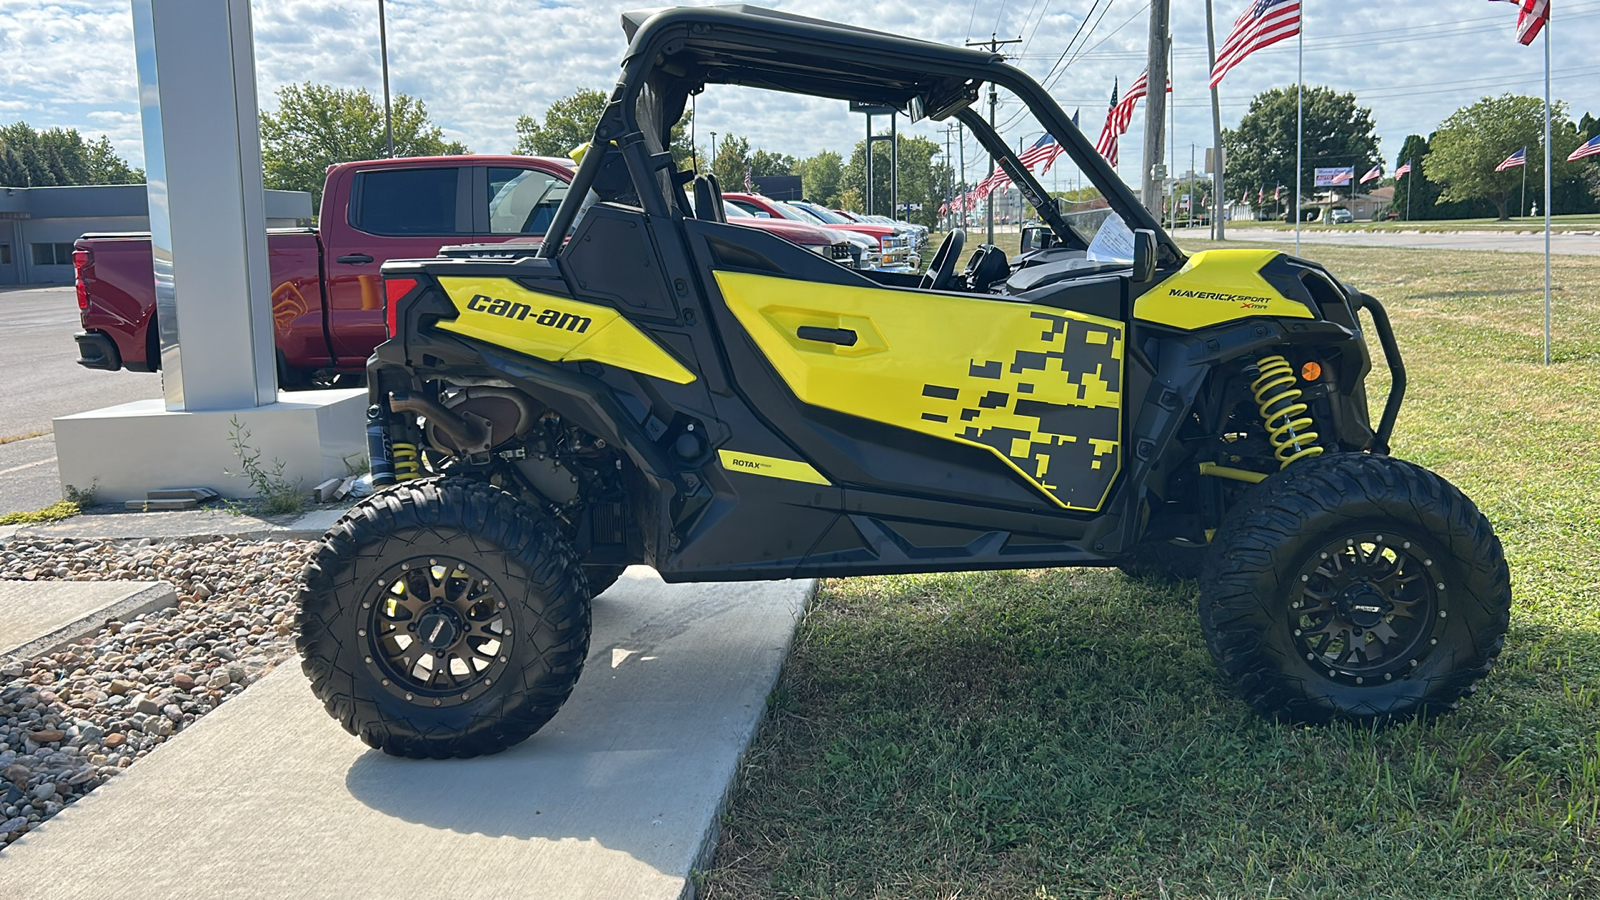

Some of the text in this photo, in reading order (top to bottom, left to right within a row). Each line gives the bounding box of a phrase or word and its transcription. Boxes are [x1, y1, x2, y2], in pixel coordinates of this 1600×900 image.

[1168, 289, 1237, 302] MAVERICK
[466, 294, 592, 334] can-am
[732, 459, 760, 469] ROTAX
